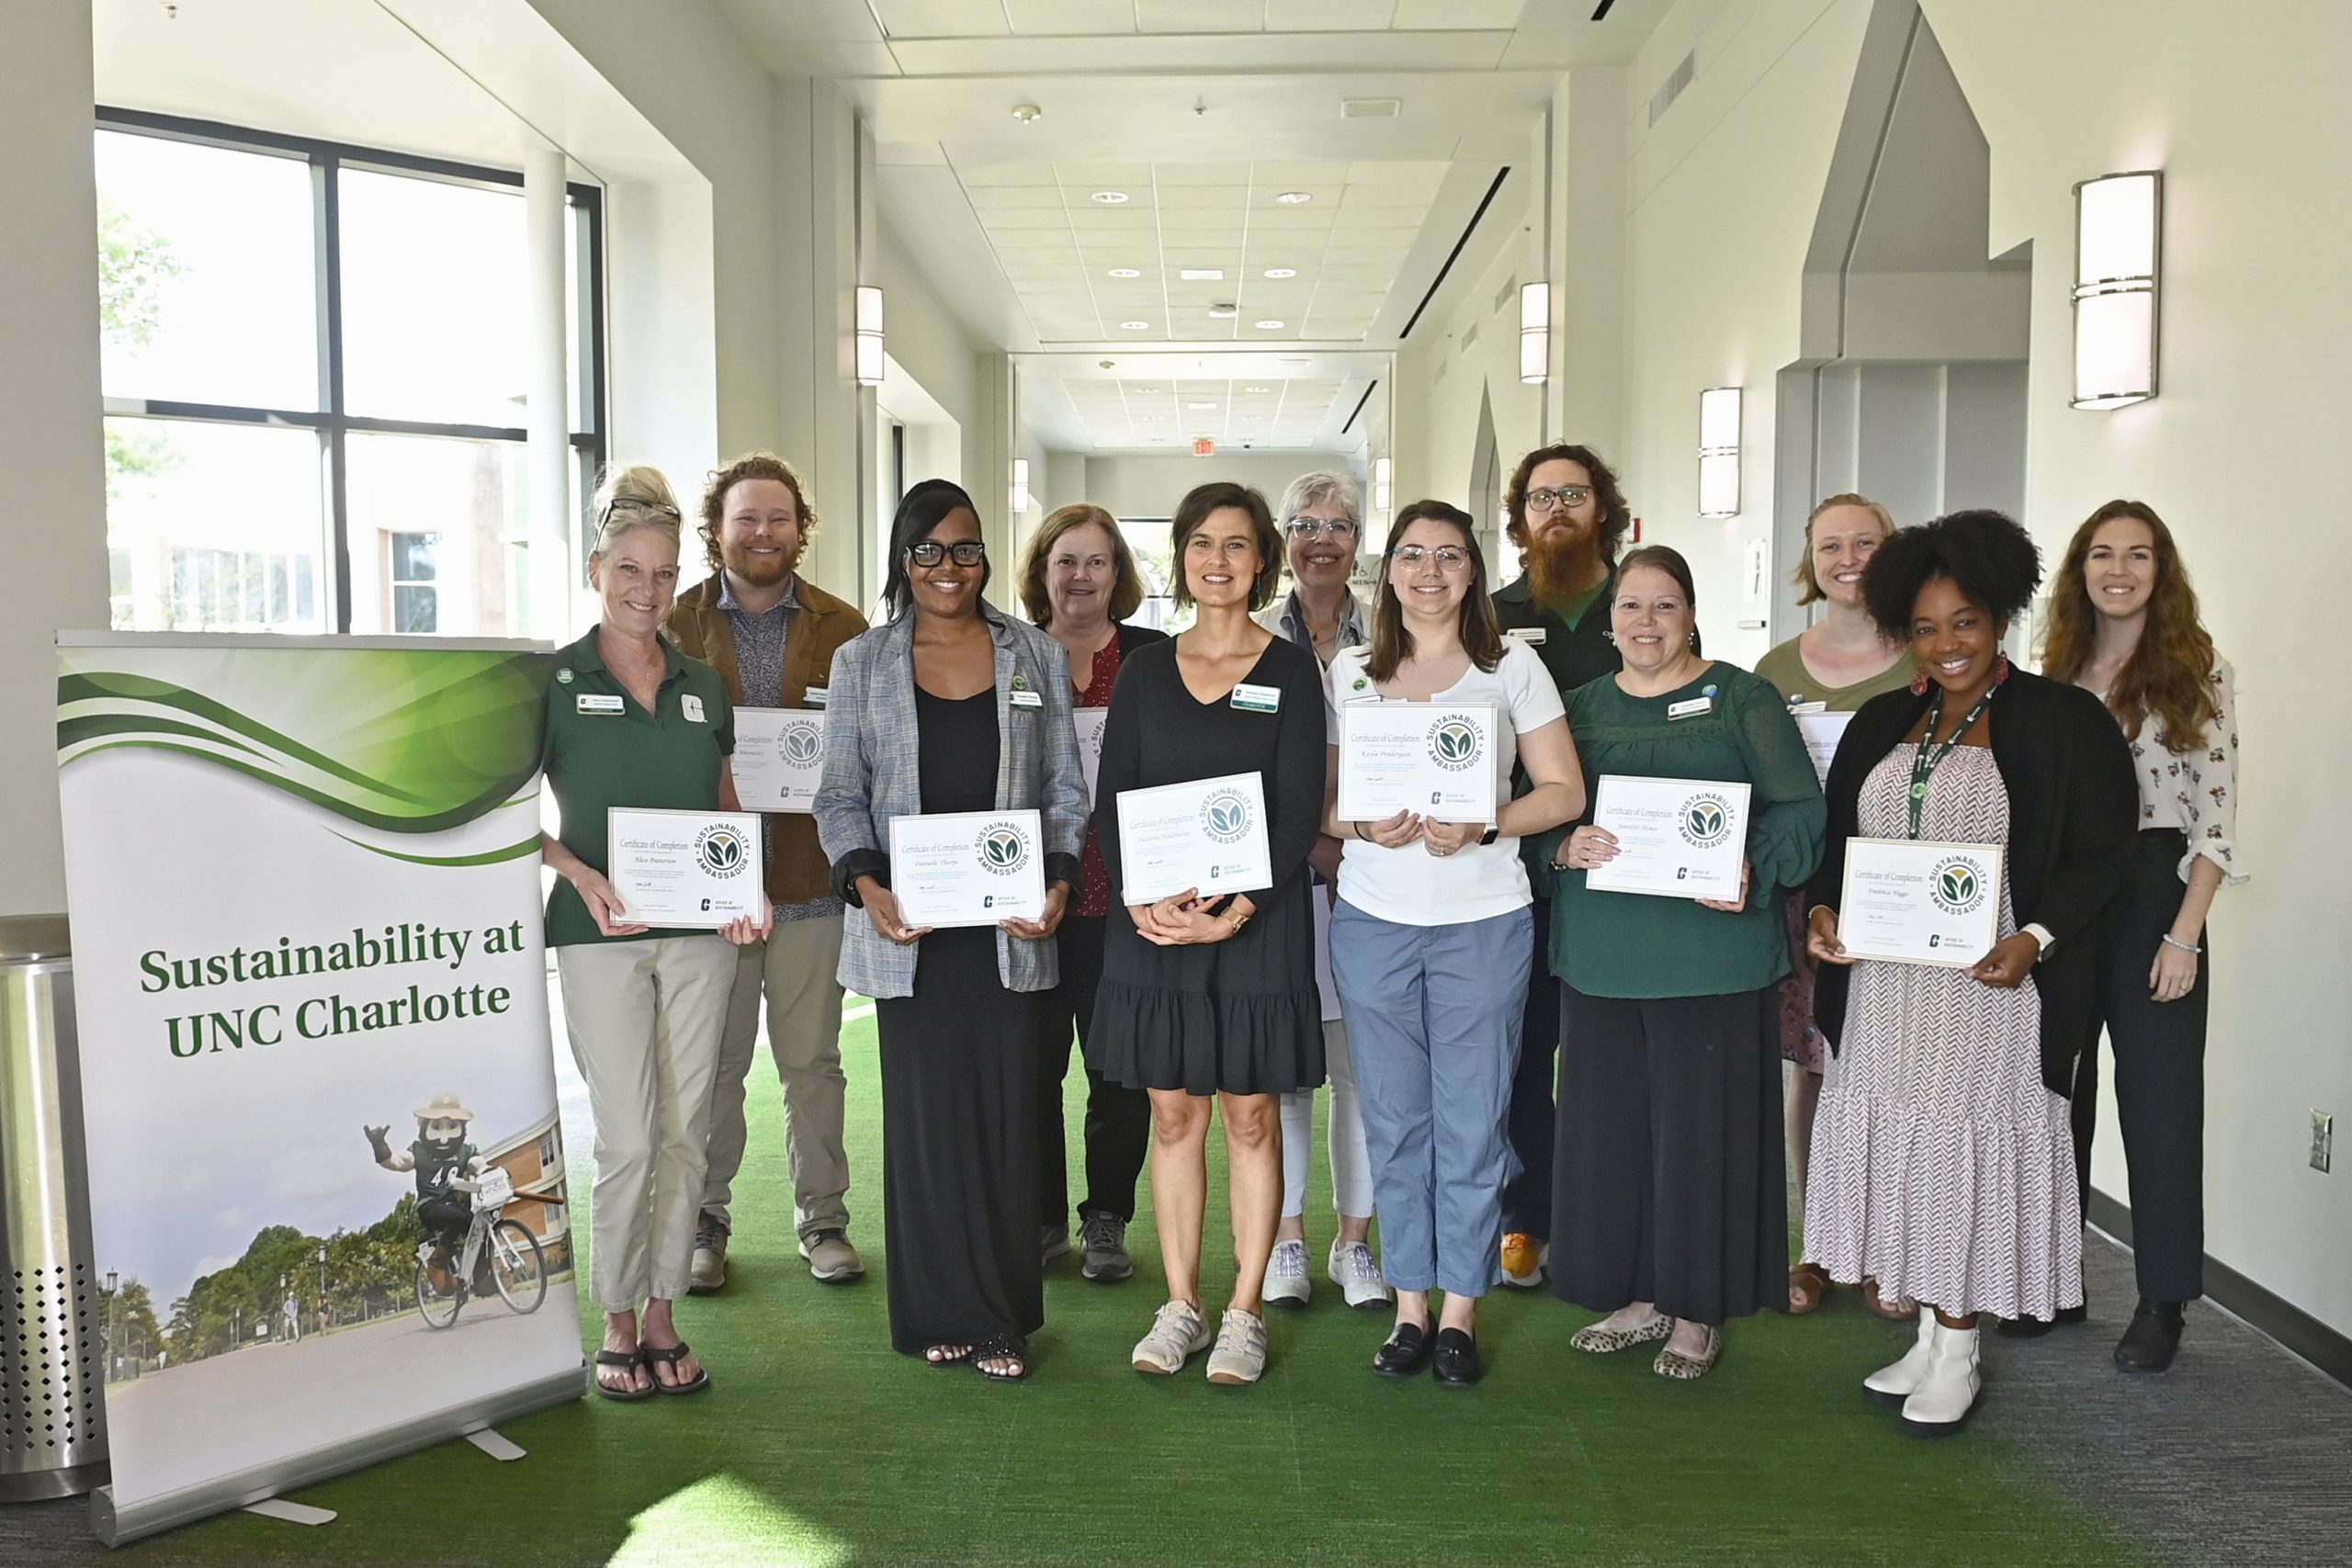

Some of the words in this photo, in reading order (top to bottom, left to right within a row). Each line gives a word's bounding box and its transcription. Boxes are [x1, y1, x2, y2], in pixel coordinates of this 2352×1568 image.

[1426, 714, 1485, 740] SUSTAINABILITY
[1428, 750, 1483, 772] AMBASSADOR
[1199, 787, 1253, 818] SUSTAINABILITY
[1678, 792, 1735, 819] SUSTAINABILITY
[619, 839, 649, 849] Certificate
[649, 840, 656, 849] of
[656, 840, 689, 851] Completion
[695, 823, 751, 849] SUSTAINABILITY
[975, 821, 1031, 847] SUSTAINABILITY
[1202, 819, 1253, 845] AMBASSADOR
[1678, 826, 1732, 850] AMBASSADOR
[695, 858, 750, 880] AMBASSADOR
[977, 854, 1030, 876] AMBASSADOR
[1929, 855, 1988, 885] SUSTAINABILITY
[1930, 892, 1984, 915] AMBASSADOR
[139, 923, 474, 993] Sustainability
[482, 919, 525, 957] at
[164, 1004, 284, 1058] UNC
[295, 984, 511, 1039] Charlotte
